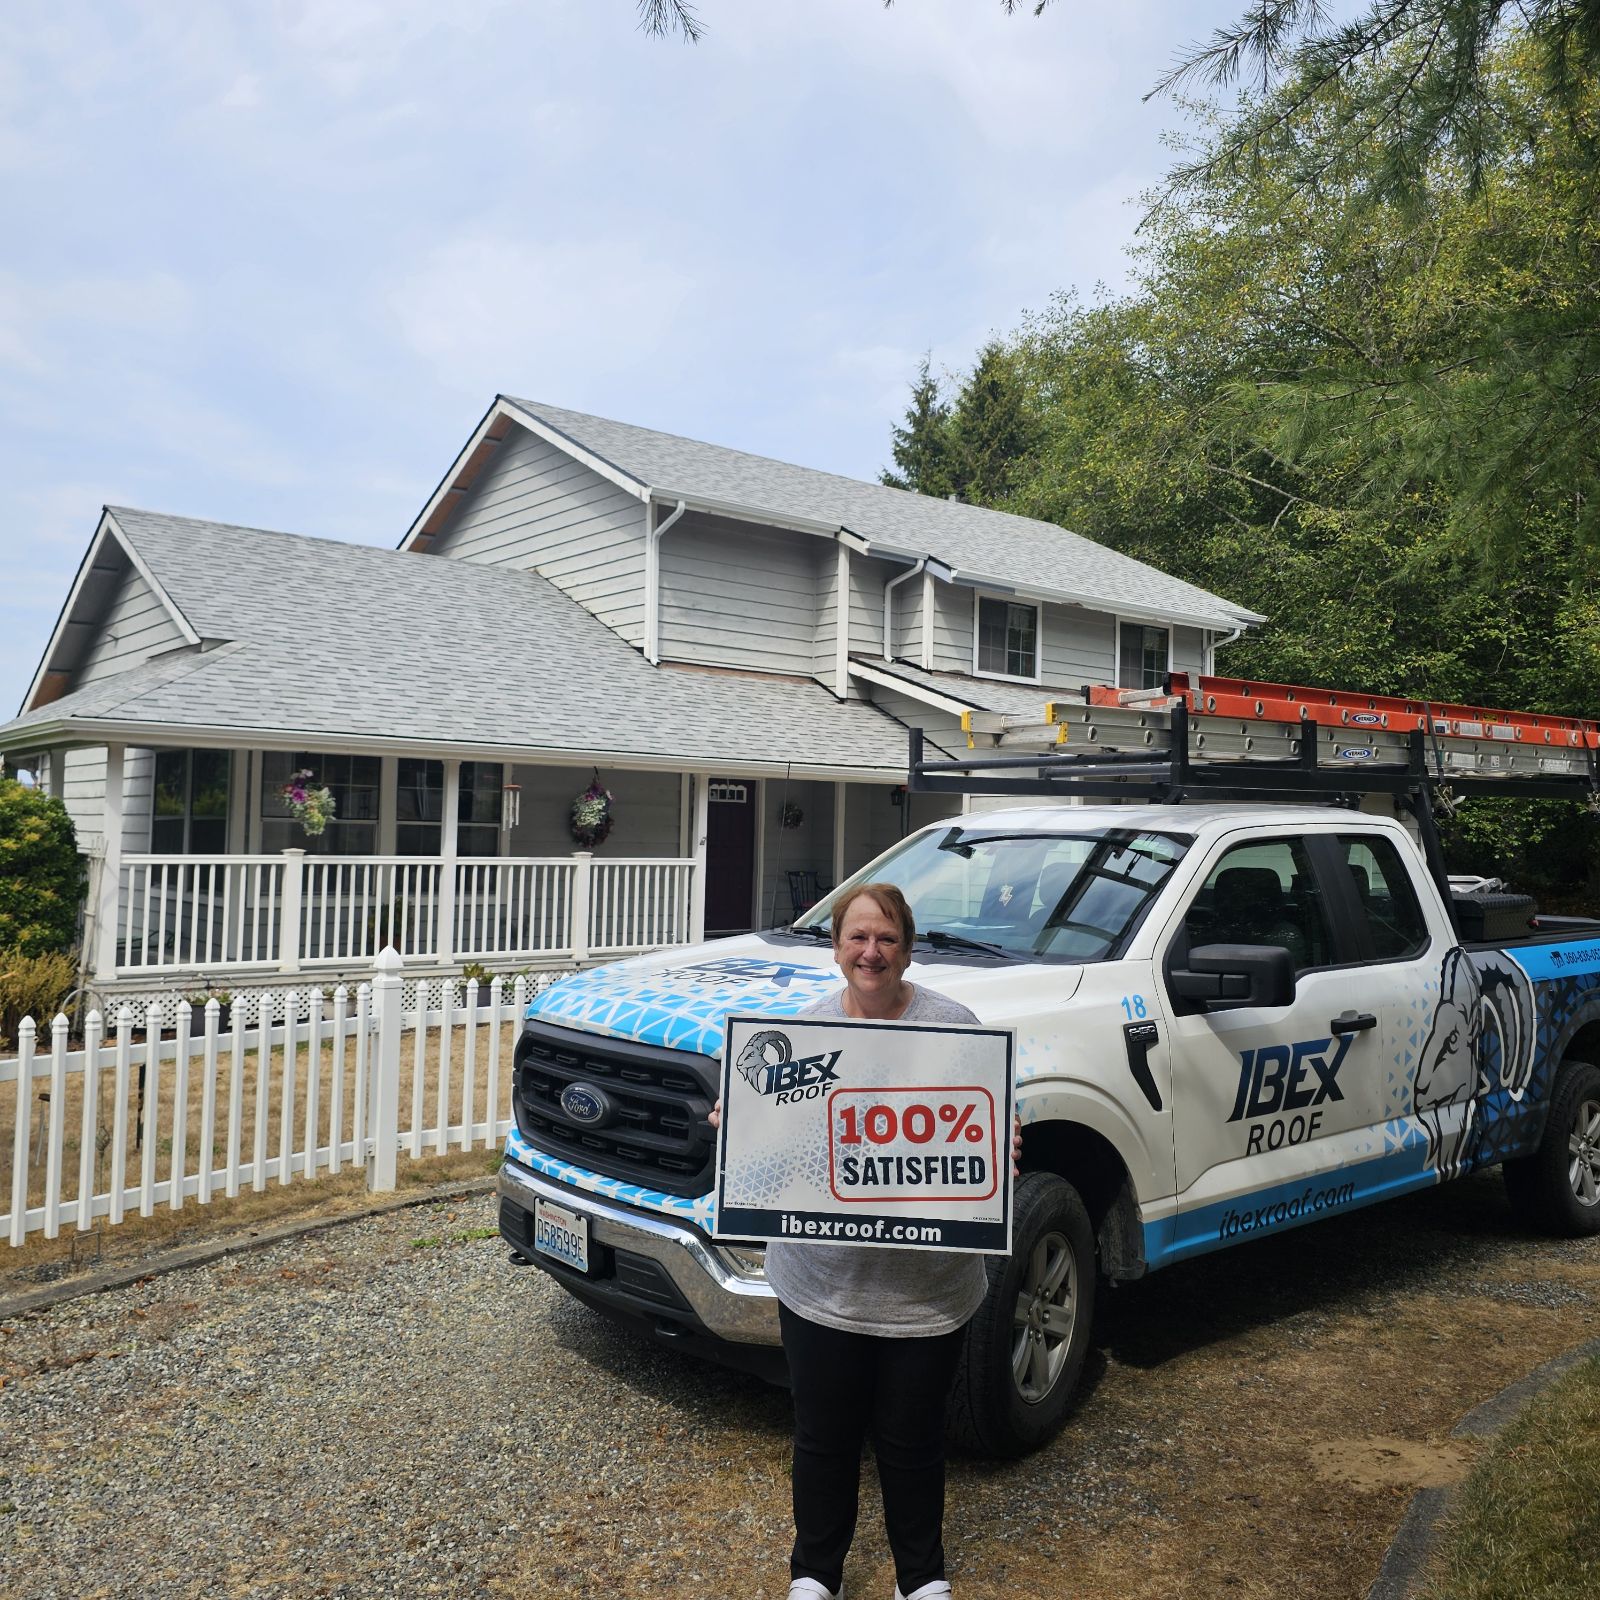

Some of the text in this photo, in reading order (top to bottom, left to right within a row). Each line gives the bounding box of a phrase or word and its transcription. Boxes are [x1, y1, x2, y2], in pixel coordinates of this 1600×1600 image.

[651, 968, 753, 985] ROOF
[683, 957, 838, 988] BEX
[1121, 994, 1147, 1020] 18
[761, 1050, 843, 1096] IBEX
[1225, 1034, 1354, 1123] IBEX
[568, 1093, 592, 1116] Ford
[775, 1082, 834, 1106] ROOF
[839, 1104, 984, 1144] 100%
[1246, 1111, 1323, 1156] ROOF
[843, 1155, 986, 1186] SATISFIED
[1219, 1181, 1355, 1241] ibexroof.com
[537, 1218, 584, 1263] D58599E
[780, 1214, 942, 1242] ibexroof.com
